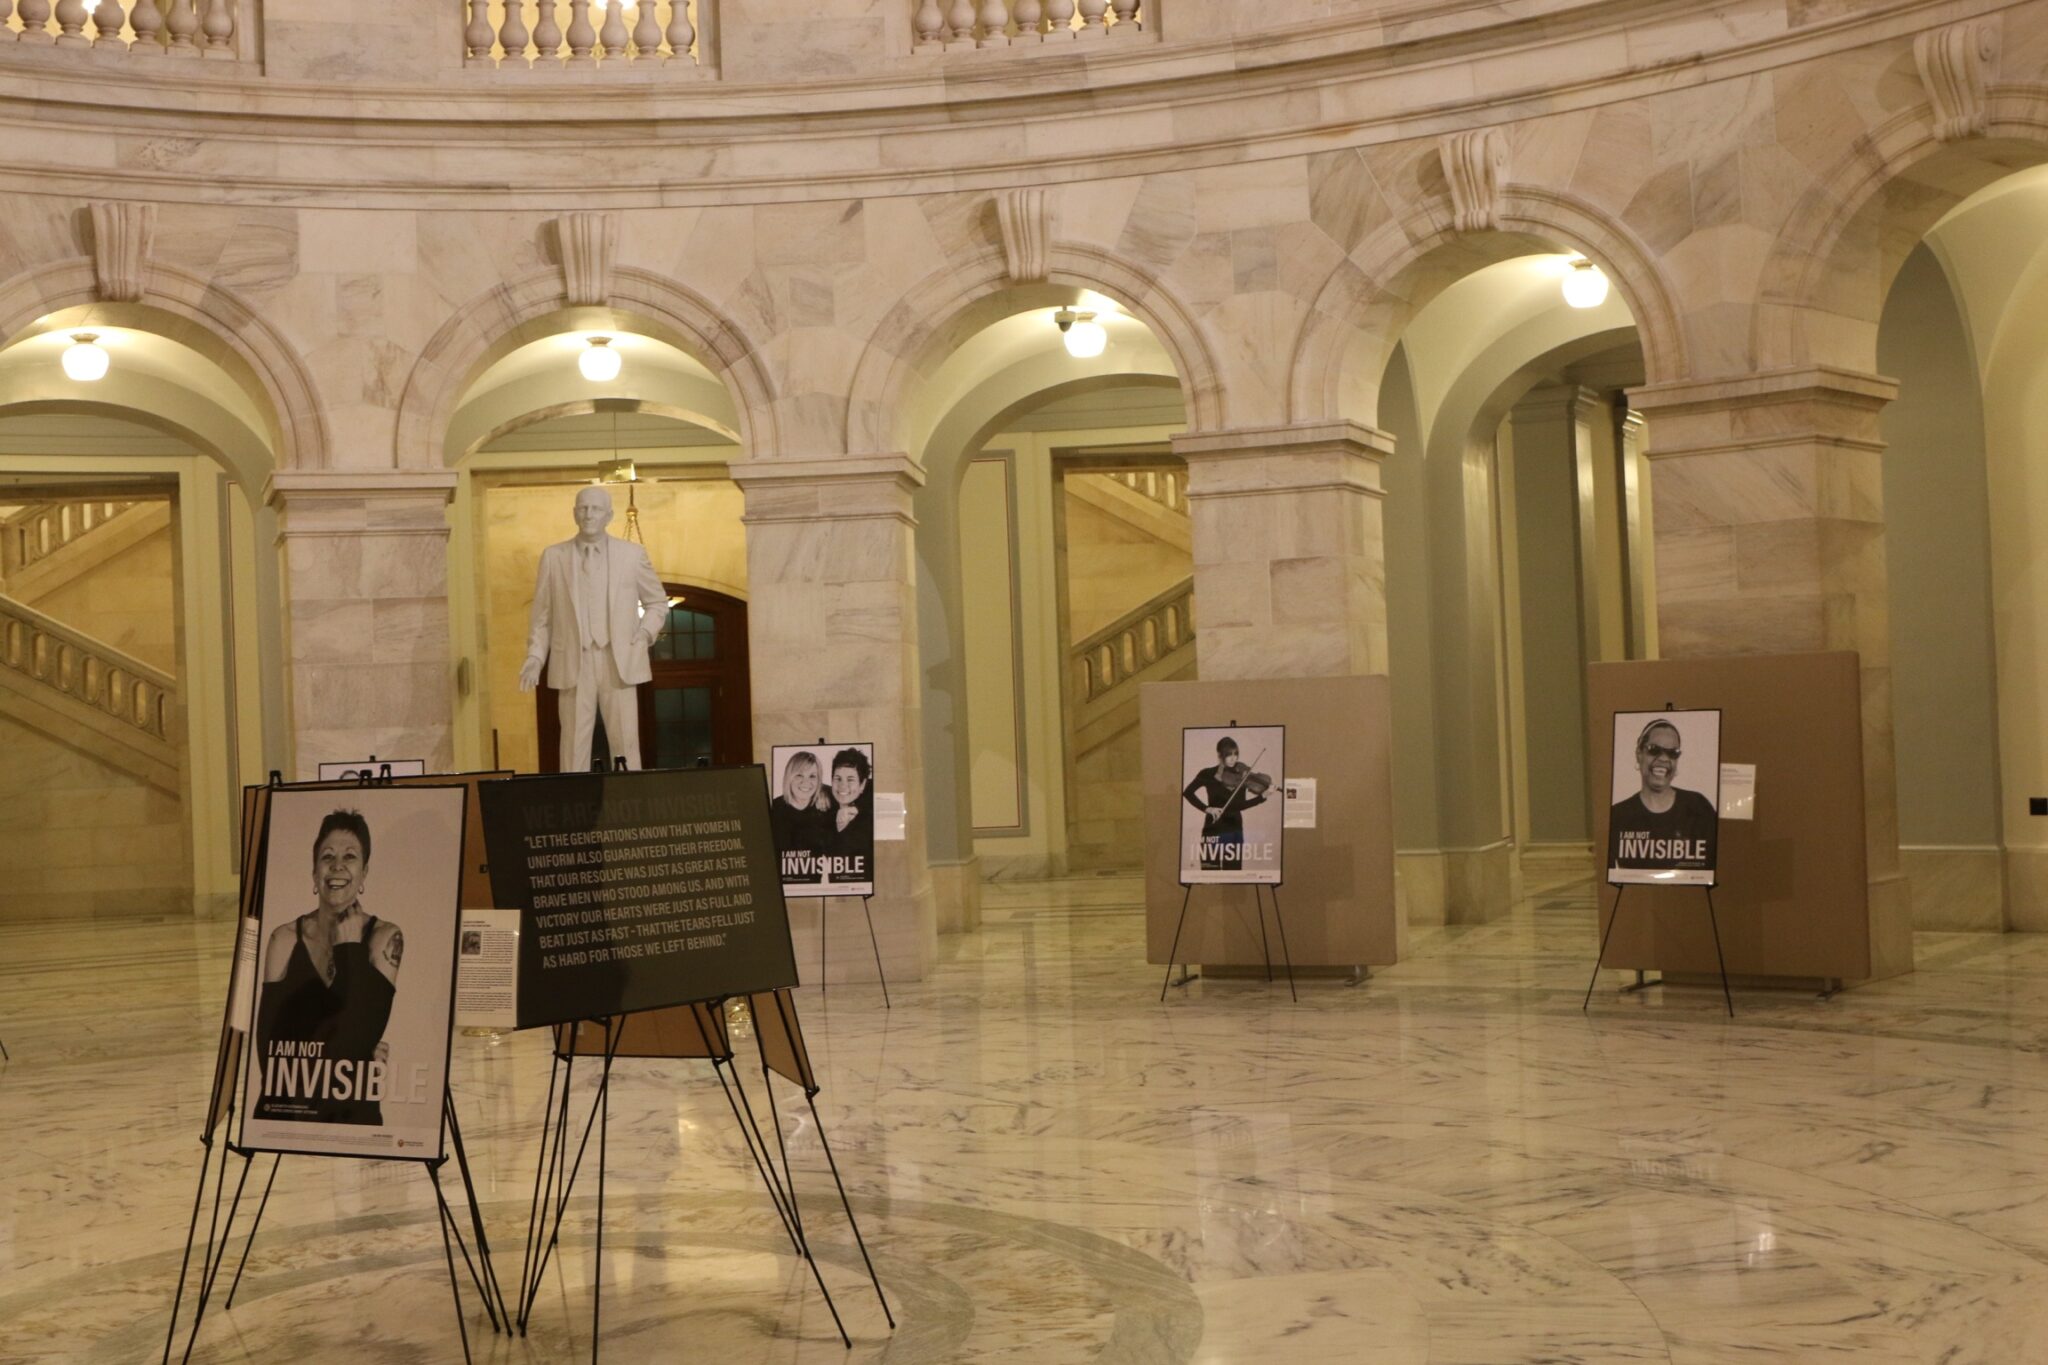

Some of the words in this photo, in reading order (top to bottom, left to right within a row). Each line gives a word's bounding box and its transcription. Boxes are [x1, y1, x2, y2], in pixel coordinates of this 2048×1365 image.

[550, 833, 570, 847] THE
[570, 829, 638, 845] GENERATIONS
[639, 826, 669, 840] KNOW
[669, 824, 694, 837] THAT
[694, 821, 730, 835] WOMEN
[730, 819, 741, 832] IN
[1623, 831, 1635, 839] AM
[1636, 831, 1650, 839] NOT
[527, 854, 575, 869] UNIFORM
[576, 851, 603, 864] ALSO
[604, 845, 668, 862] GUARANTEED
[669, 842, 696, 856] THEIR
[698, 838, 744, 853] FREEDOM.
[785, 850, 796, 858] AM
[797, 850, 811, 858] NOT
[1190, 842, 1273, 861] INVISIBLE
[1618, 839, 1707, 860] INVISIBLE
[530, 874, 556, 889] THAT
[557, 872, 579, 886] OUR
[580, 867, 624, 884] RESOLVE
[624, 865, 647, 879] WAS
[648, 864, 670, 877] JUST
[671, 862, 684, 875] AS
[685, 859, 715, 873] GREAT
[715, 858, 729, 871] AS
[729, 856, 747, 869] THE
[782, 855, 864, 875] INVISIBLE
[533, 894, 567, 909] BRAVE
[569, 892, 591, 905] MEN
[592, 888, 616, 903] WHO
[617, 885, 650, 900] STOOD
[652, 881, 687, 897] AMONG
[688, 879, 704, 892] US.
[705, 877, 725, 890] AND
[725, 874, 749, 888] WITH
[536, 912, 579, 928] VICTORY
[581, 910, 603, 923] OUR
[603, 905, 642, 920] HEARTS
[643, 902, 671, 916] WERE
[672, 899, 695, 913] JUST
[696, 897, 708, 910] AS
[709, 895, 733, 908] FULL
[732, 893, 752, 906] AND
[539, 935, 565, 949] BEAT
[566, 932, 591, 946] JUST
[591, 930, 605, 942] AS
[605, 927, 630, 941] FAST
[636, 923, 662, 937] THAT
[661, 921, 681, 934] THE
[680, 917, 711, 932] TEARS
[711, 914, 734, 927] FELL
[734, 911, 755, 924] JUST
[543, 955, 557, 969] AS
[558, 952, 587, 966] HARD
[589, 949, 609, 962] FOR
[611, 945, 643, 960] THOSE
[644, 942, 662, 955] WE
[663, 939, 685, 953] LEFT
[268, 1040, 274, 1056] I
[275, 1041, 295, 1057] AM
[298, 1042, 325, 1057] NOT
[264, 1057, 430, 1104] INVISIBLE
